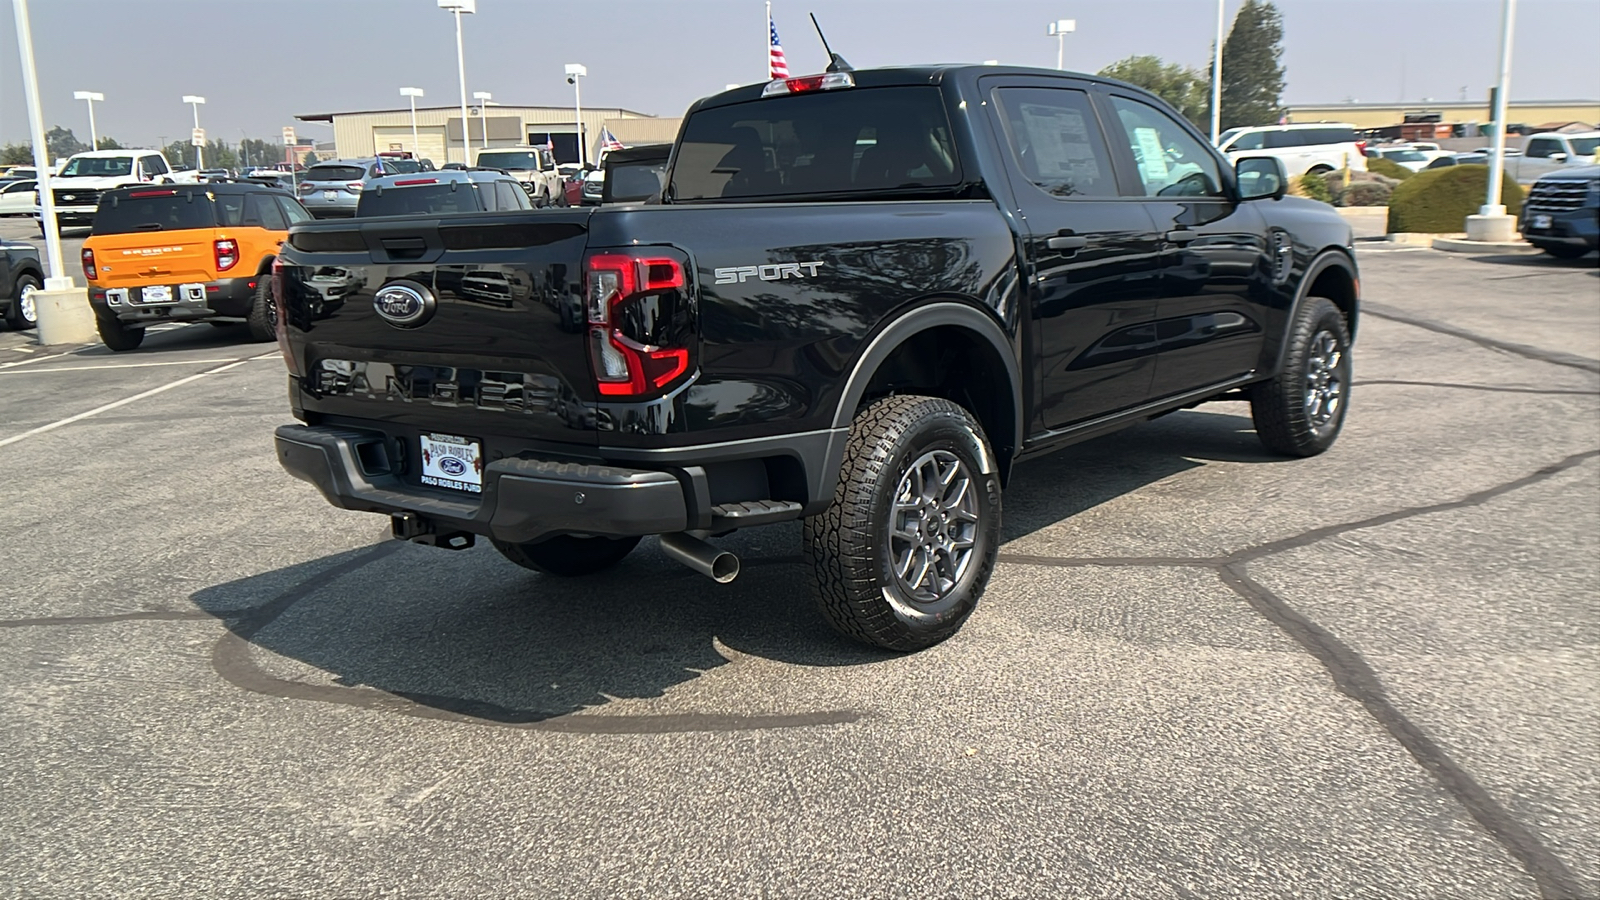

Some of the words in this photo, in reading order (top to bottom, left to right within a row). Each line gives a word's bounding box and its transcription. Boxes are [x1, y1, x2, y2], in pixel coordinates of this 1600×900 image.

[714, 261, 825, 285] SPORT
[380, 292, 411, 314] Ford
[315, 370, 561, 416] RANGER
[430, 443, 447, 458] PASO
[448, 446, 474, 464] ROBLES
[421, 475, 438, 486] PASO
[438, 478, 463, 490] ROBLES
